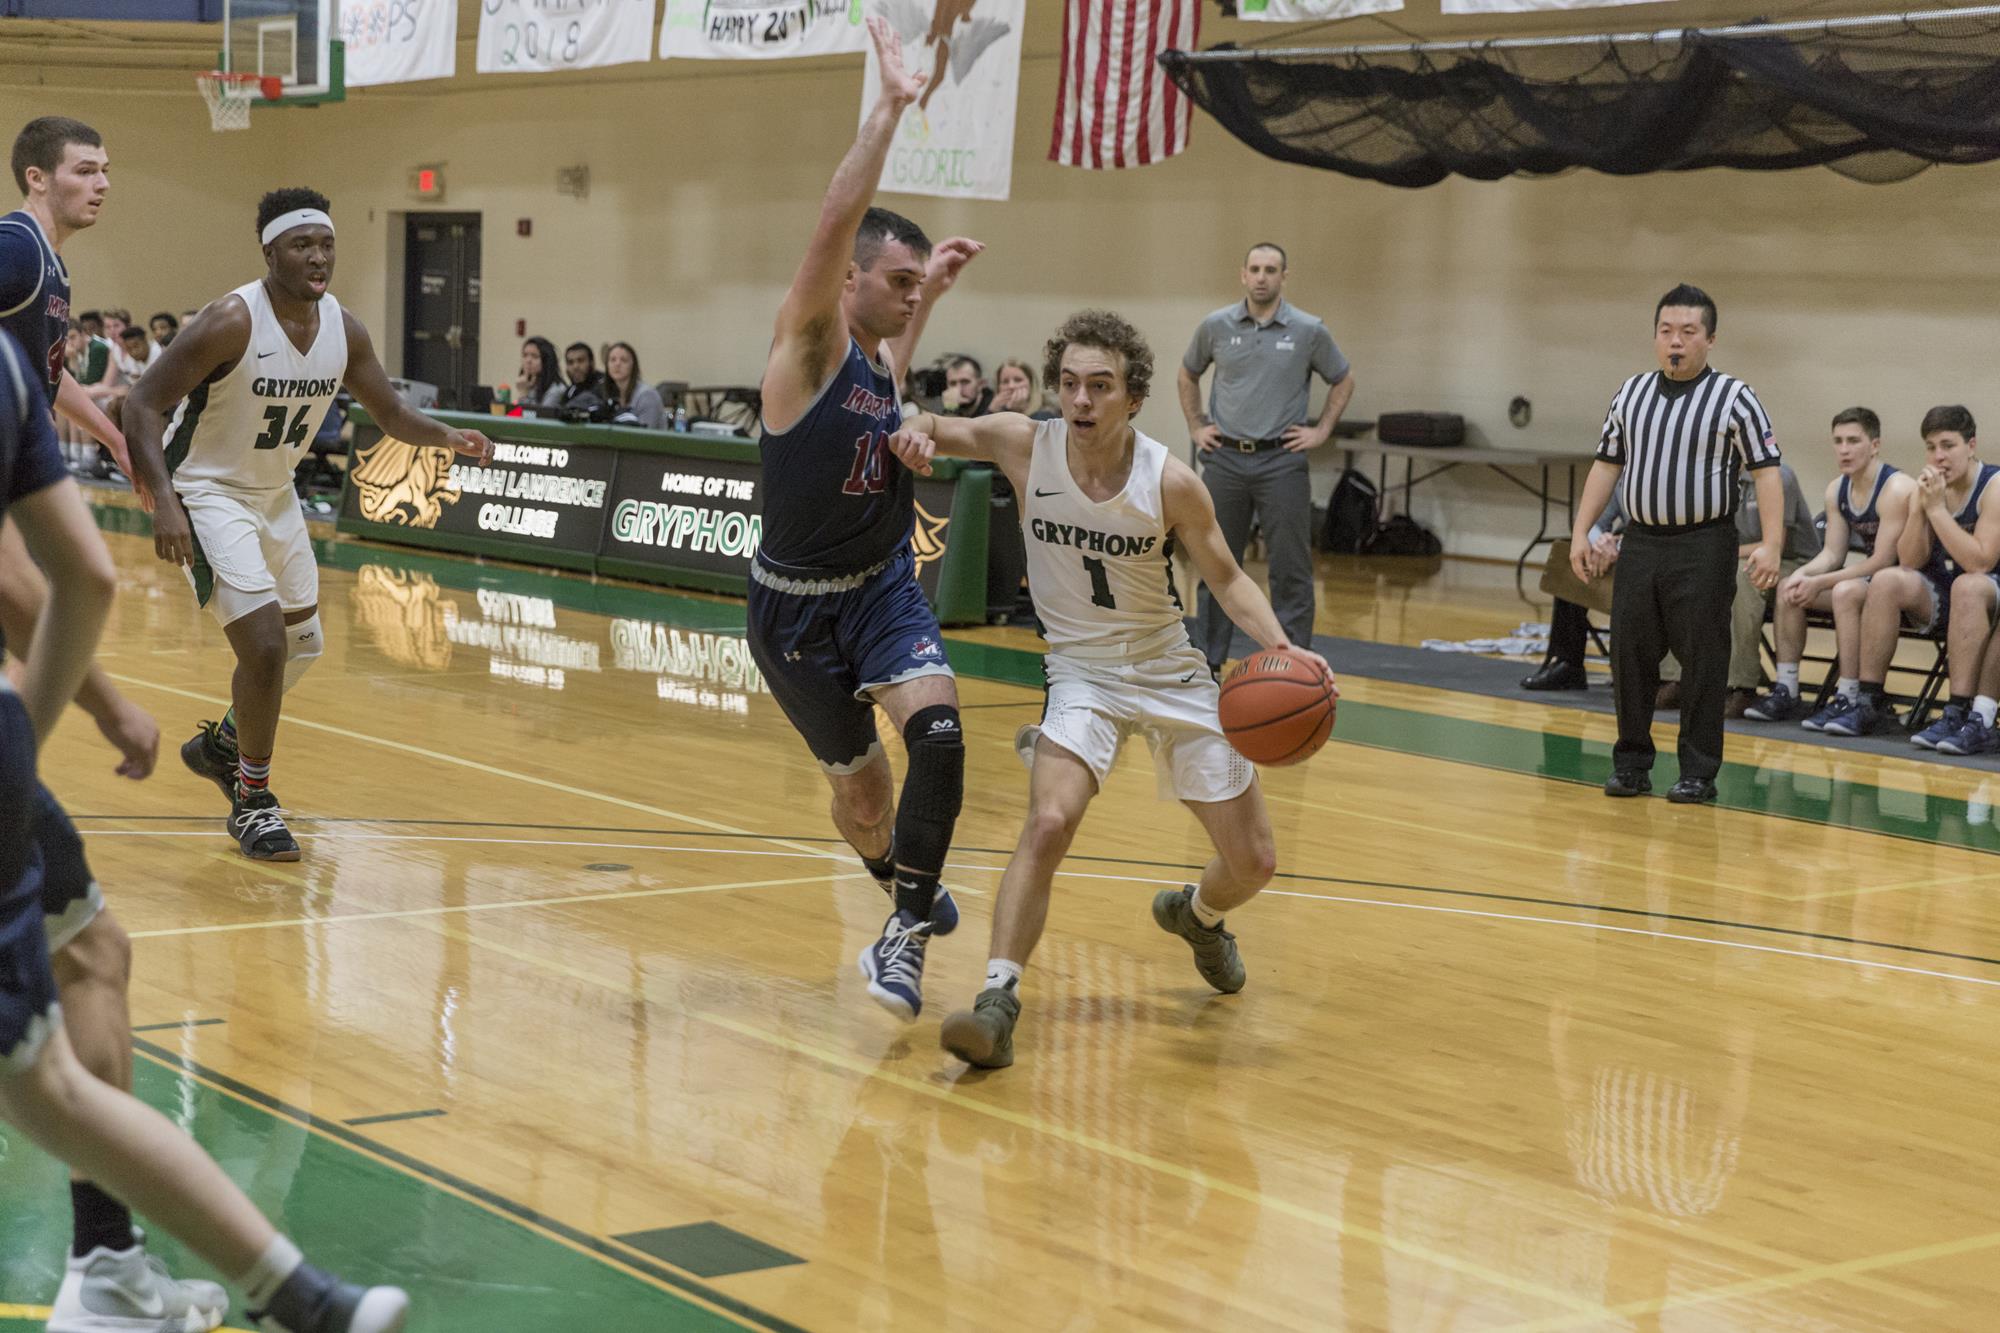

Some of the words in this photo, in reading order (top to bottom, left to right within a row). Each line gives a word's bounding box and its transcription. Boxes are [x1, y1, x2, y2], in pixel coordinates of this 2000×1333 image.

[501, 21, 580, 65] 2018
[709, 13, 759, 45] HAPPY
[893, 147, 976, 188] GODRIC
[252, 377, 337, 398] GRYPHONS
[254, 405, 312, 450] 34
[492, 442, 550, 466] WELCOME
[551, 448, 569, 468] TO
[446, 463, 507, 496] SARAH
[505, 470, 607, 508] LAWRENCE
[661, 472, 704, 496] HOME
[704, 476, 725, 497] OF
[726, 479, 755, 500] THE
[478, 502, 559, 539] COLLEGE
[1031, 518, 1157, 557] GRYPHONS
[1082, 555, 1116, 609] 1
